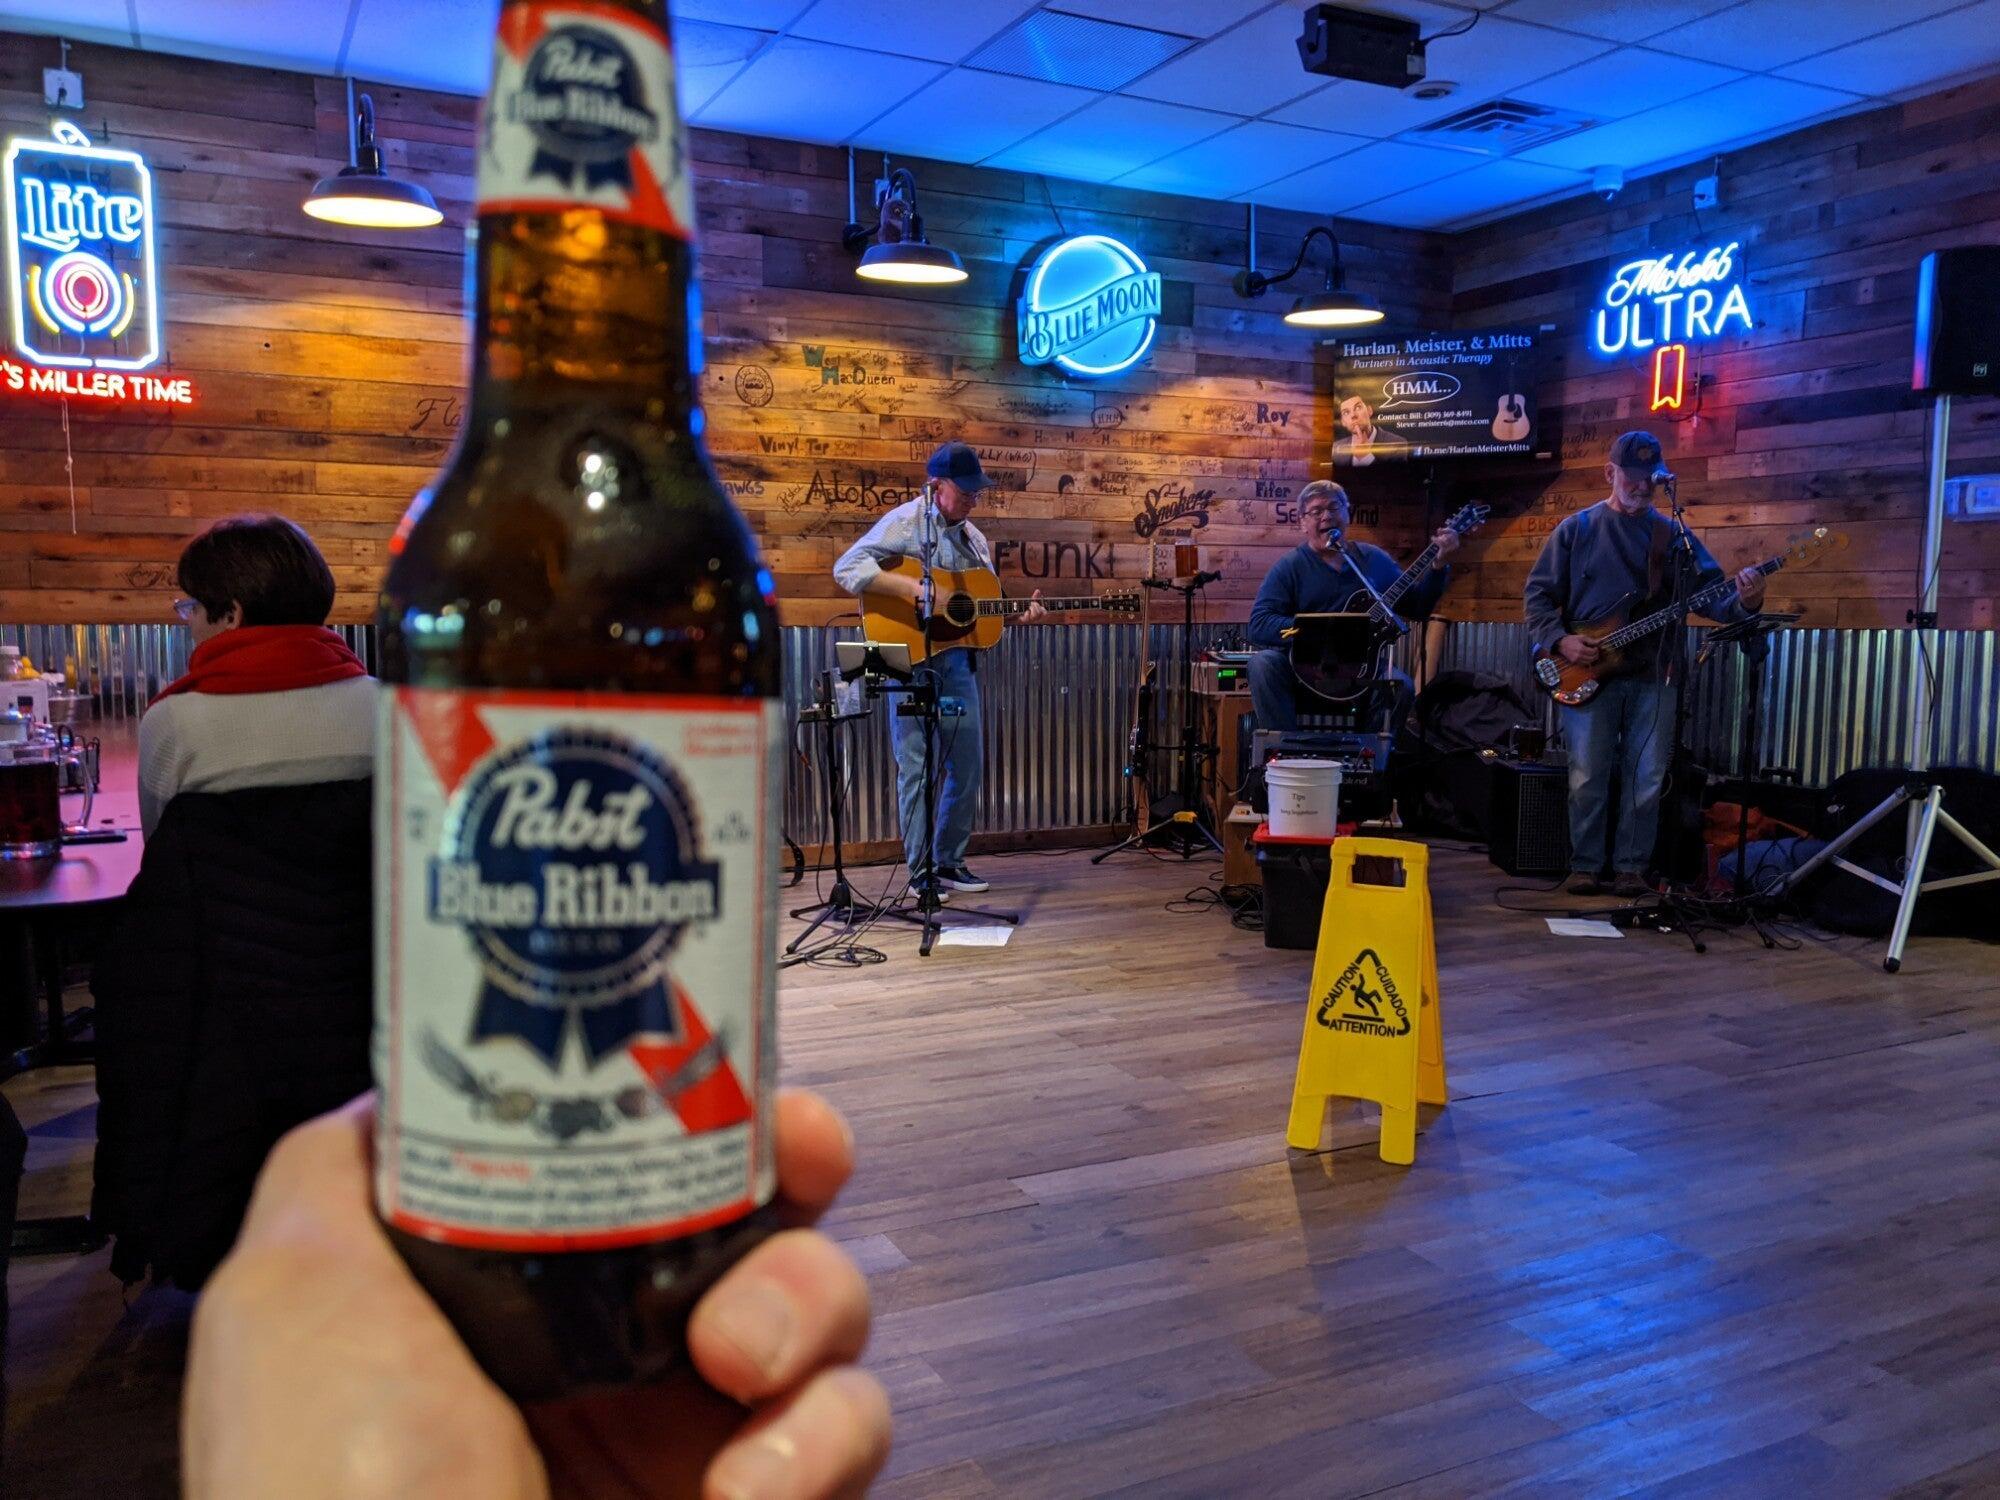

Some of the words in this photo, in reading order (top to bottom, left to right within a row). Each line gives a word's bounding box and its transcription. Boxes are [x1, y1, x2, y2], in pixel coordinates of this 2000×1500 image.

[1028, 304, 1094, 360] BLUE
[1096, 278, 1158, 329] MOON
[1597, 284, 1753, 353] ULTRA
[1343, 341, 1401, 358] Harlan,
[1405, 337, 1467, 354] Meister,
[1470, 336, 1484, 350] &
[1489, 334, 1532, 350] Mitts
[1352, 358, 1394, 370] Partners
[1395, 357, 1406, 367] in
[1407, 355, 1450, 367] Acoustic
[1452, 353, 1493, 366] Therapy
[29, 367, 127, 398] MILLER
[129, 376, 193, 404] TIME
[1257, 403, 1290, 427] Roy
[491, 762, 654, 851] Pabst
[435, 860, 538, 926] Blue
[541, 862, 716, 929] Ribbon
[1322, 962, 1361, 1009] CAUTION
[1375, 965, 1408, 1018] CUIDADO
[1328, 1019, 1396, 1038] ATTENTION
